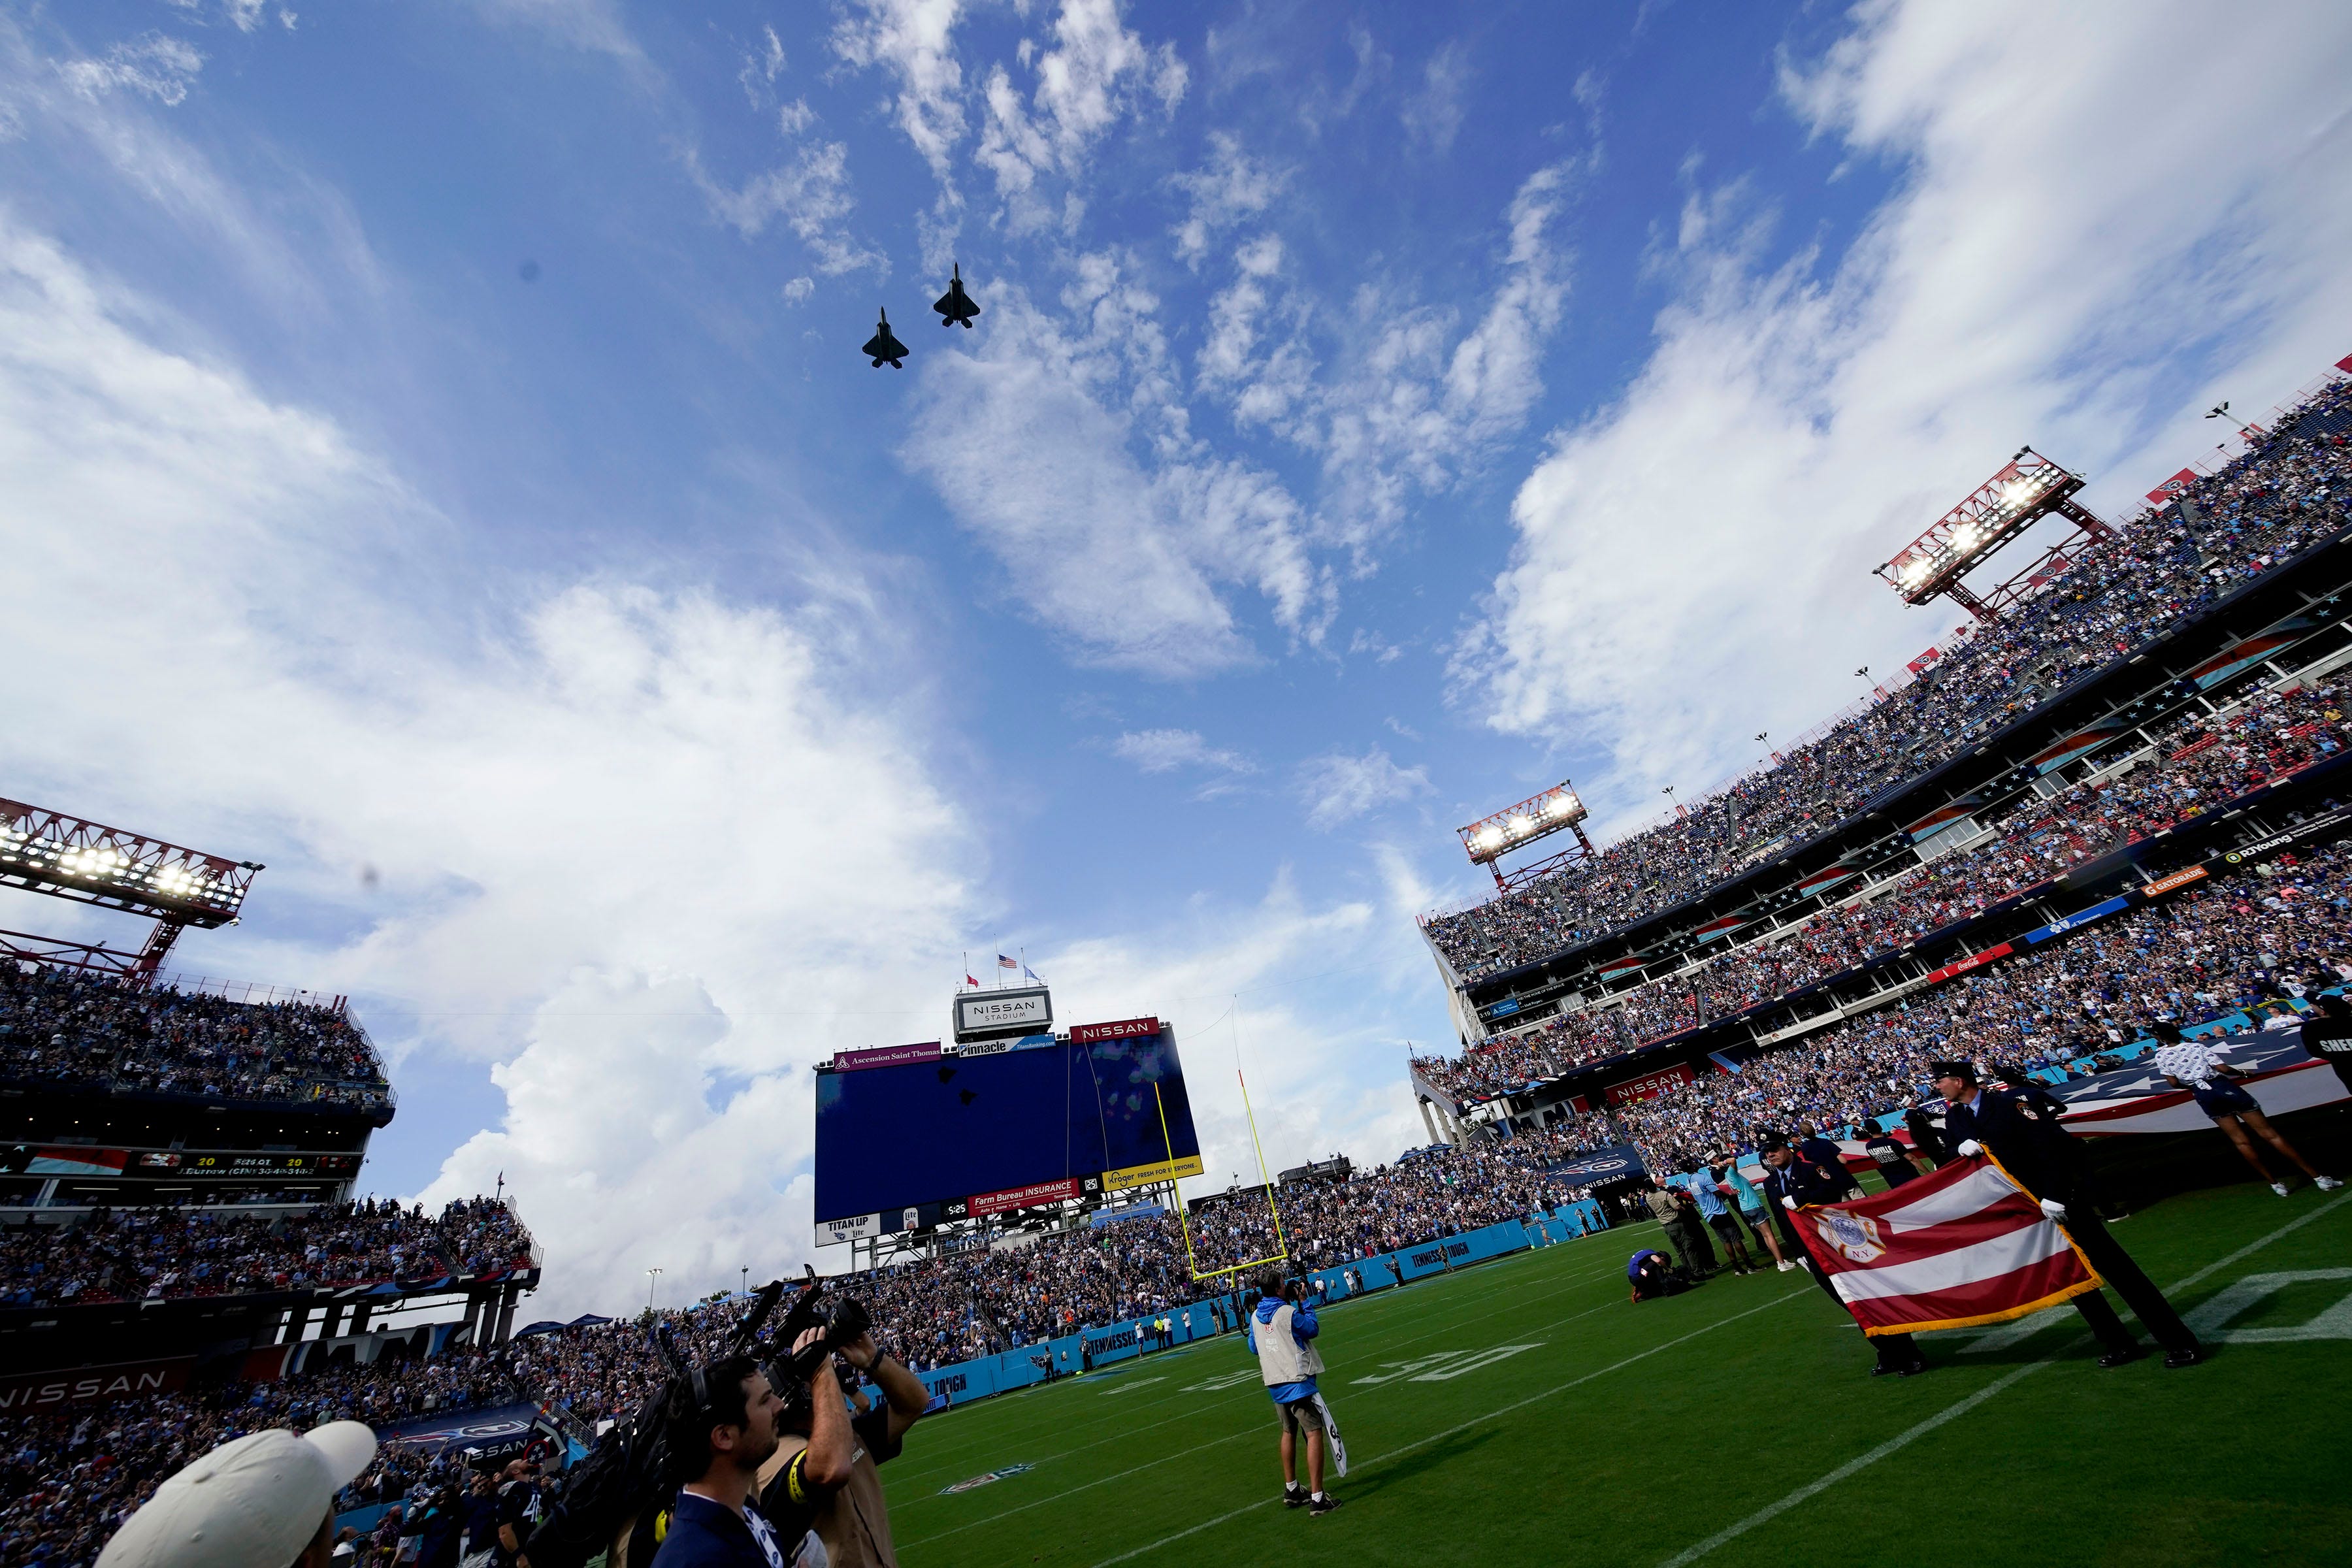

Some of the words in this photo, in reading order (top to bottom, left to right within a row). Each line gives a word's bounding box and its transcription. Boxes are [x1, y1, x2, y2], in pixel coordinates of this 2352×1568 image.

[2156, 868, 2204, 890] GATORADE
[2077, 913, 2102, 926] Tennessee
[973, 1001, 1035, 1015] NISSAN
[985, 1012, 1026, 1021] STADIUM
[1083, 1022, 1148, 1039] NISSAN
[960, 1041, 1006, 1056] Pinnacle
[1017, 1040, 1055, 1050] TitansBanking.com
[852, 1053, 890, 1065] Ascension
[891, 1051, 911, 1060] Saint
[912, 1049, 940, 1058] Thomas
[1617, 1073, 1682, 1099] NISSAN
[1868, 1145, 1893, 1156] NASHVILLE
[197, 1158, 216, 1166] 20
[286, 1158, 302, 1166] 20
[1086, 1180, 1096, 1189] 25
[1108, 1171, 1135, 1187] Kroger
[1585, 1173, 1626, 1189] NISSAN
[975, 1196, 995, 1206] Farm
[997, 1192, 1024, 1202] Bureau
[1025, 1181, 1072, 1196] INSURANCE
[905, 1211, 917, 1220] Lite
[948, 1204, 966, 1215] 5:25
[828, 1218, 855, 1232] TITAN
[856, 1216, 868, 1226] UP
[852, 1229, 864, 1238] Lite
[1411, 1249, 1444, 1268] TENNESS
[1447, 1241, 1469, 1258] TOUGH
[1852, 1250, 1873, 1258] N.Y.
[1090, 1330, 1137, 1356] TENNESSEE
[459, 1439, 528, 1463] ISSAN
